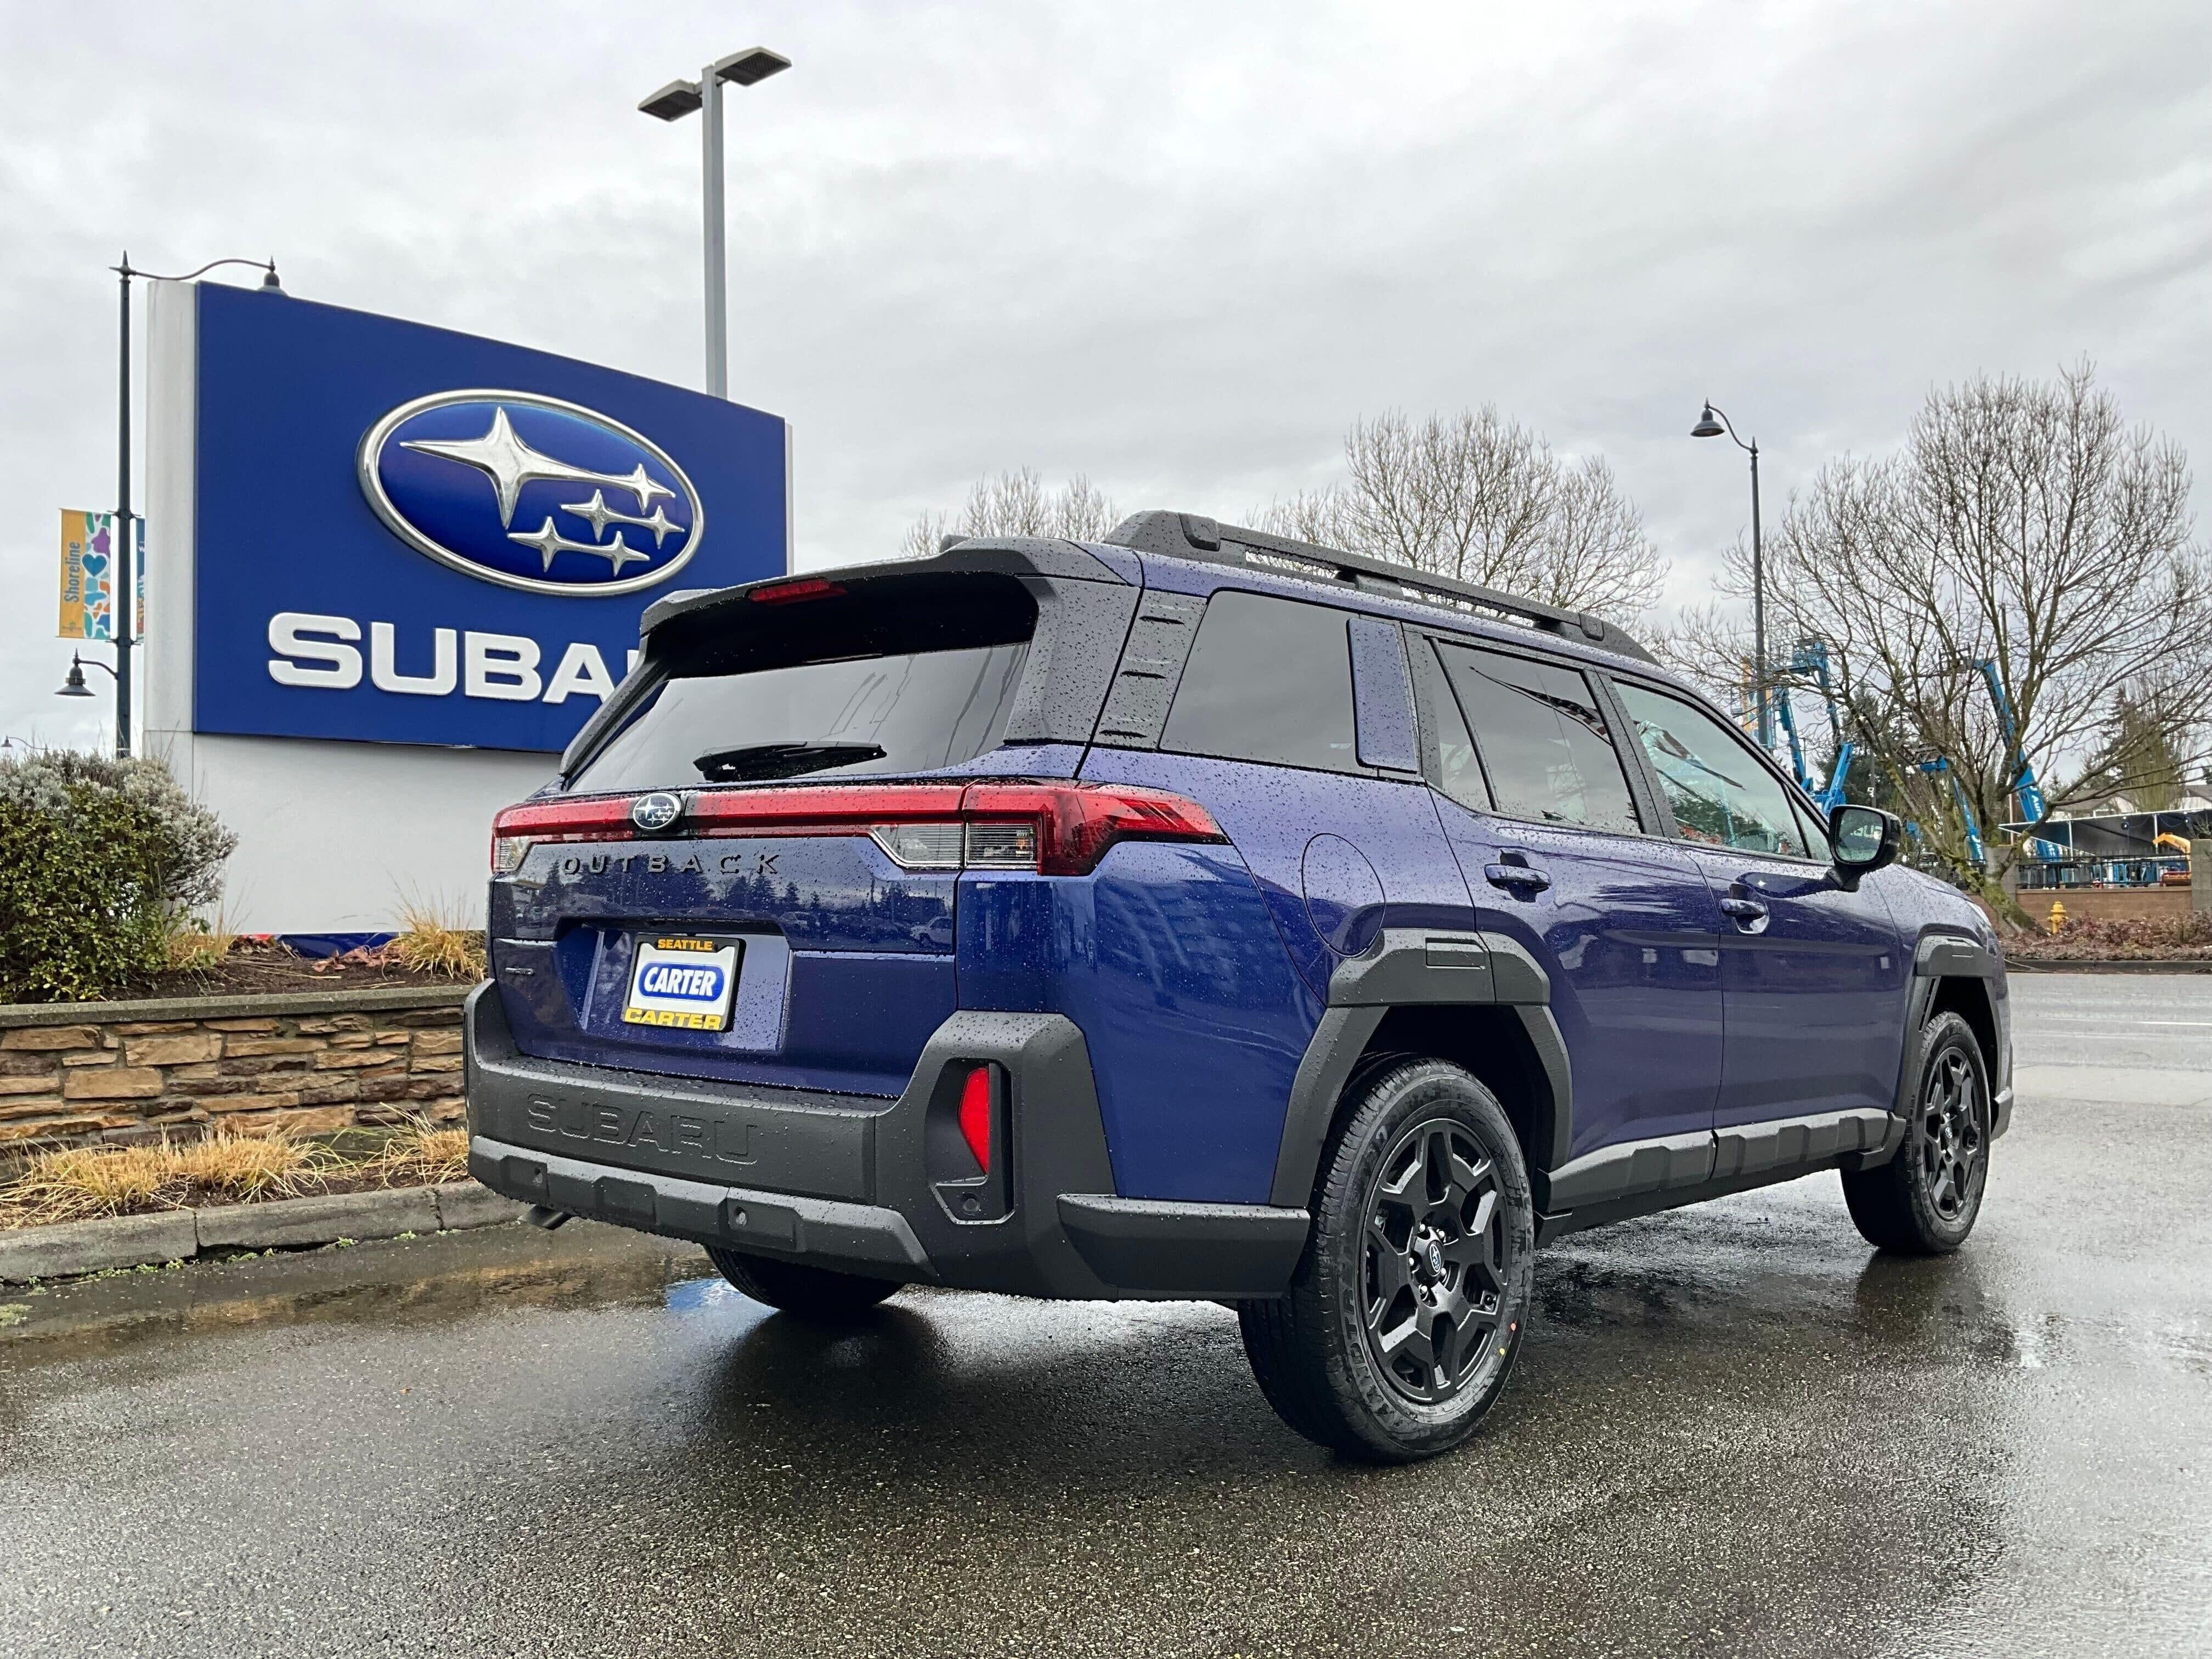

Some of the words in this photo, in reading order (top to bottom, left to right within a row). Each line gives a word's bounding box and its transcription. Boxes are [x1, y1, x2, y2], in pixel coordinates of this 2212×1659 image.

[64, 541, 81, 603] Shoreline
[269, 612, 639, 704] SUBA
[564, 854, 780, 874] OUTBACK
[657, 939, 713, 951] SEATTLE
[644, 966, 717, 997] CARTER
[624, 1008, 721, 1030] CARTER
[527, 1093, 758, 1165] SUBARU
